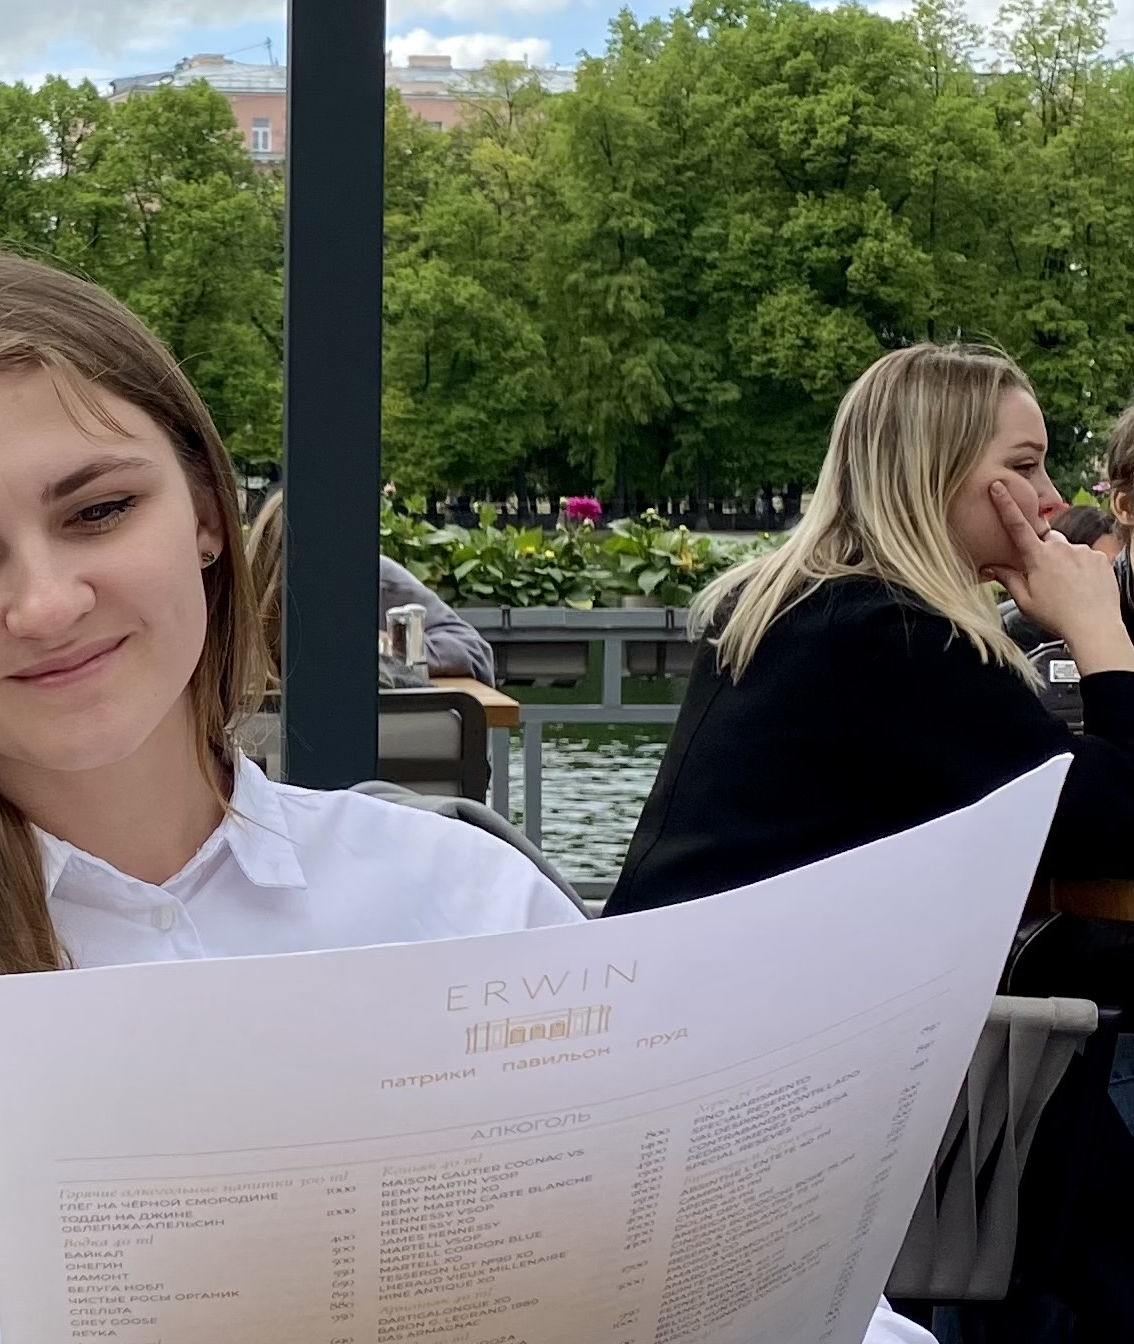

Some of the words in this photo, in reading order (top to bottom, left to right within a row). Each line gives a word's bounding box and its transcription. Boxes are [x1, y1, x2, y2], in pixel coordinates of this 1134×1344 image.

[446, 959, 638, 1012] ERWIN
[380, 1067, 476, 1089] патрики
[502, 1045, 611, 1072] павильон
[636, 1027, 689, 1050] пруд
[470, 1113, 591, 1141] АЛКОГОЛЬ
[380, 1173, 437, 1188] MAISON
[504, 1152, 563, 1170] COGNAC
[566, 1147, 584, 1159] VS
[380, 1185, 420, 1198] REMY
[423, 1176, 477, 1192] MARTIN
[480, 1170, 518, 1184] VSOP
[380, 1195, 419, 1208] REMY
[422, 1187, 477, 1202] MARTIN
[479, 1183, 499, 1194] XO
[380, 1204, 419, 1217] REMY
[422, 1196, 476, 1212] MARTIN
[479, 1187, 523, 1203] CARTE
[380, 1209, 454, 1227] HENNESSY
[380, 1219, 453, 1236] HENNESSY
[456, 1215, 475, 1226] XO
[379, 1232, 424, 1246] JAMES
[427, 1220, 500, 1239] HENNESSY
[379, 1239, 442, 1255] MARTELL
[444, 1232, 482, 1246] VSOP
[379, 1248, 438, 1266] MARTELL
[508, 1230, 542, 1244] BLUE
[378, 1258, 440, 1274] MARTELL
[443, 1254, 462, 1265] XO
[66, 1272, 128, 1282] МАМОНТ
[476, 1274, 495, 1285] XO
[70, 1318, 106, 1327] GREY
[109, 1317, 158, 1326] GOOSE
[71, 1329, 117, 1337] REYKA
